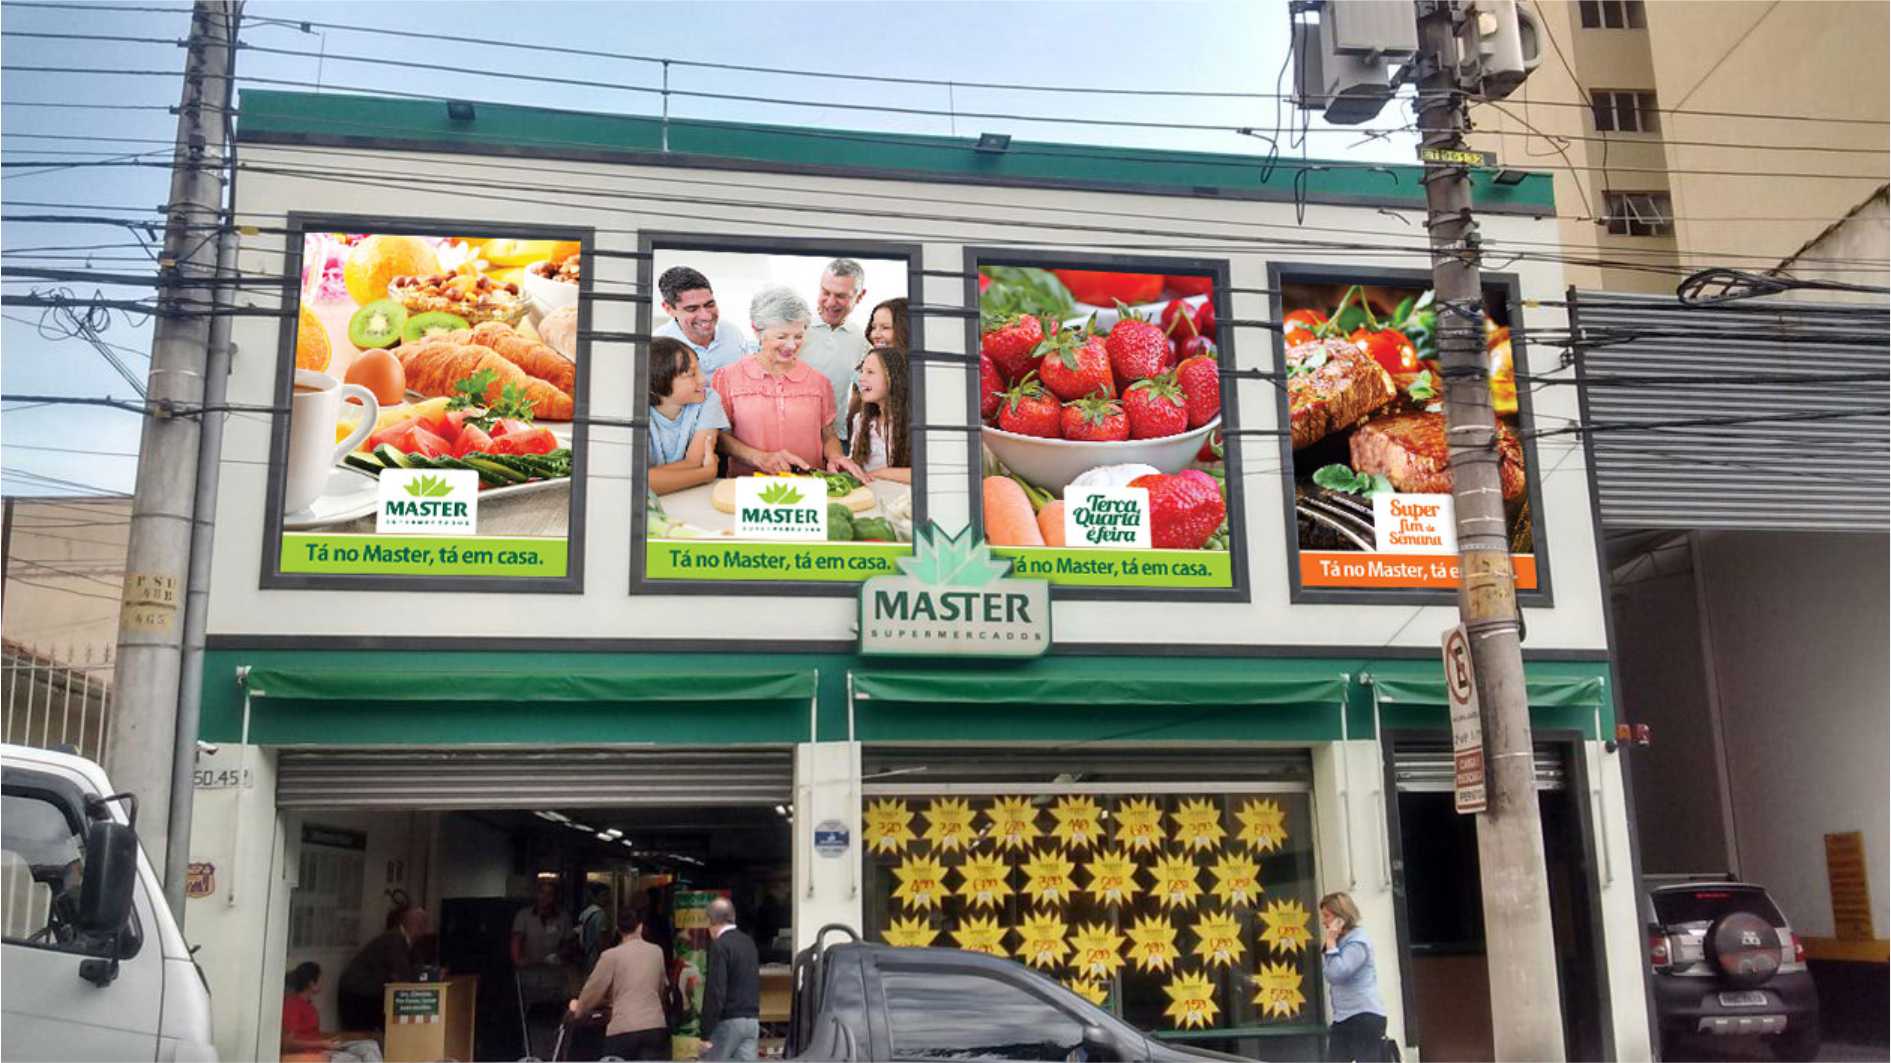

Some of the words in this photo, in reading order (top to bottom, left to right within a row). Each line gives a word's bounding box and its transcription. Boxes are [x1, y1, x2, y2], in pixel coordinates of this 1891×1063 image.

[385, 501, 468, 517] MASTER
[742, 508, 818, 525] MASTER
[1391, 499, 1440, 520] Super
[1399, 519, 1424, 534] fim
[1389, 531, 1443, 546] Semana
[306, 543, 328, 561] Tá
[334, 548, 359, 562] no
[363, 544, 434, 566] Master,
[439, 546, 458, 564] tá
[462, 550, 493, 564] em
[497, 550, 544, 565] casa.
[669, 550, 691, 568] Tá
[696, 554, 719, 568] no
[724, 551, 791, 571] Master,
[795, 553, 811, 569] tá
[815, 556, 845, 570] em
[848, 556, 891, 570] casa.
[1031, 560, 1052, 573] no
[1057, 557, 1118, 577] Master,
[1122, 559, 1139, 575] tá
[1142, 563, 1169, 575] em
[1172, 563, 1212, 576] casa.
[1319, 560, 1340, 577] Tá
[1344, 564, 1364, 577] no
[1368, 560, 1428, 581] Master,
[1430, 562, 1447, 578] tá
[1450, 567, 1462, 578] e
[875, 591, 1032, 623] MASTER
[871, 629, 1041, 641] SUPERMERCADOS
